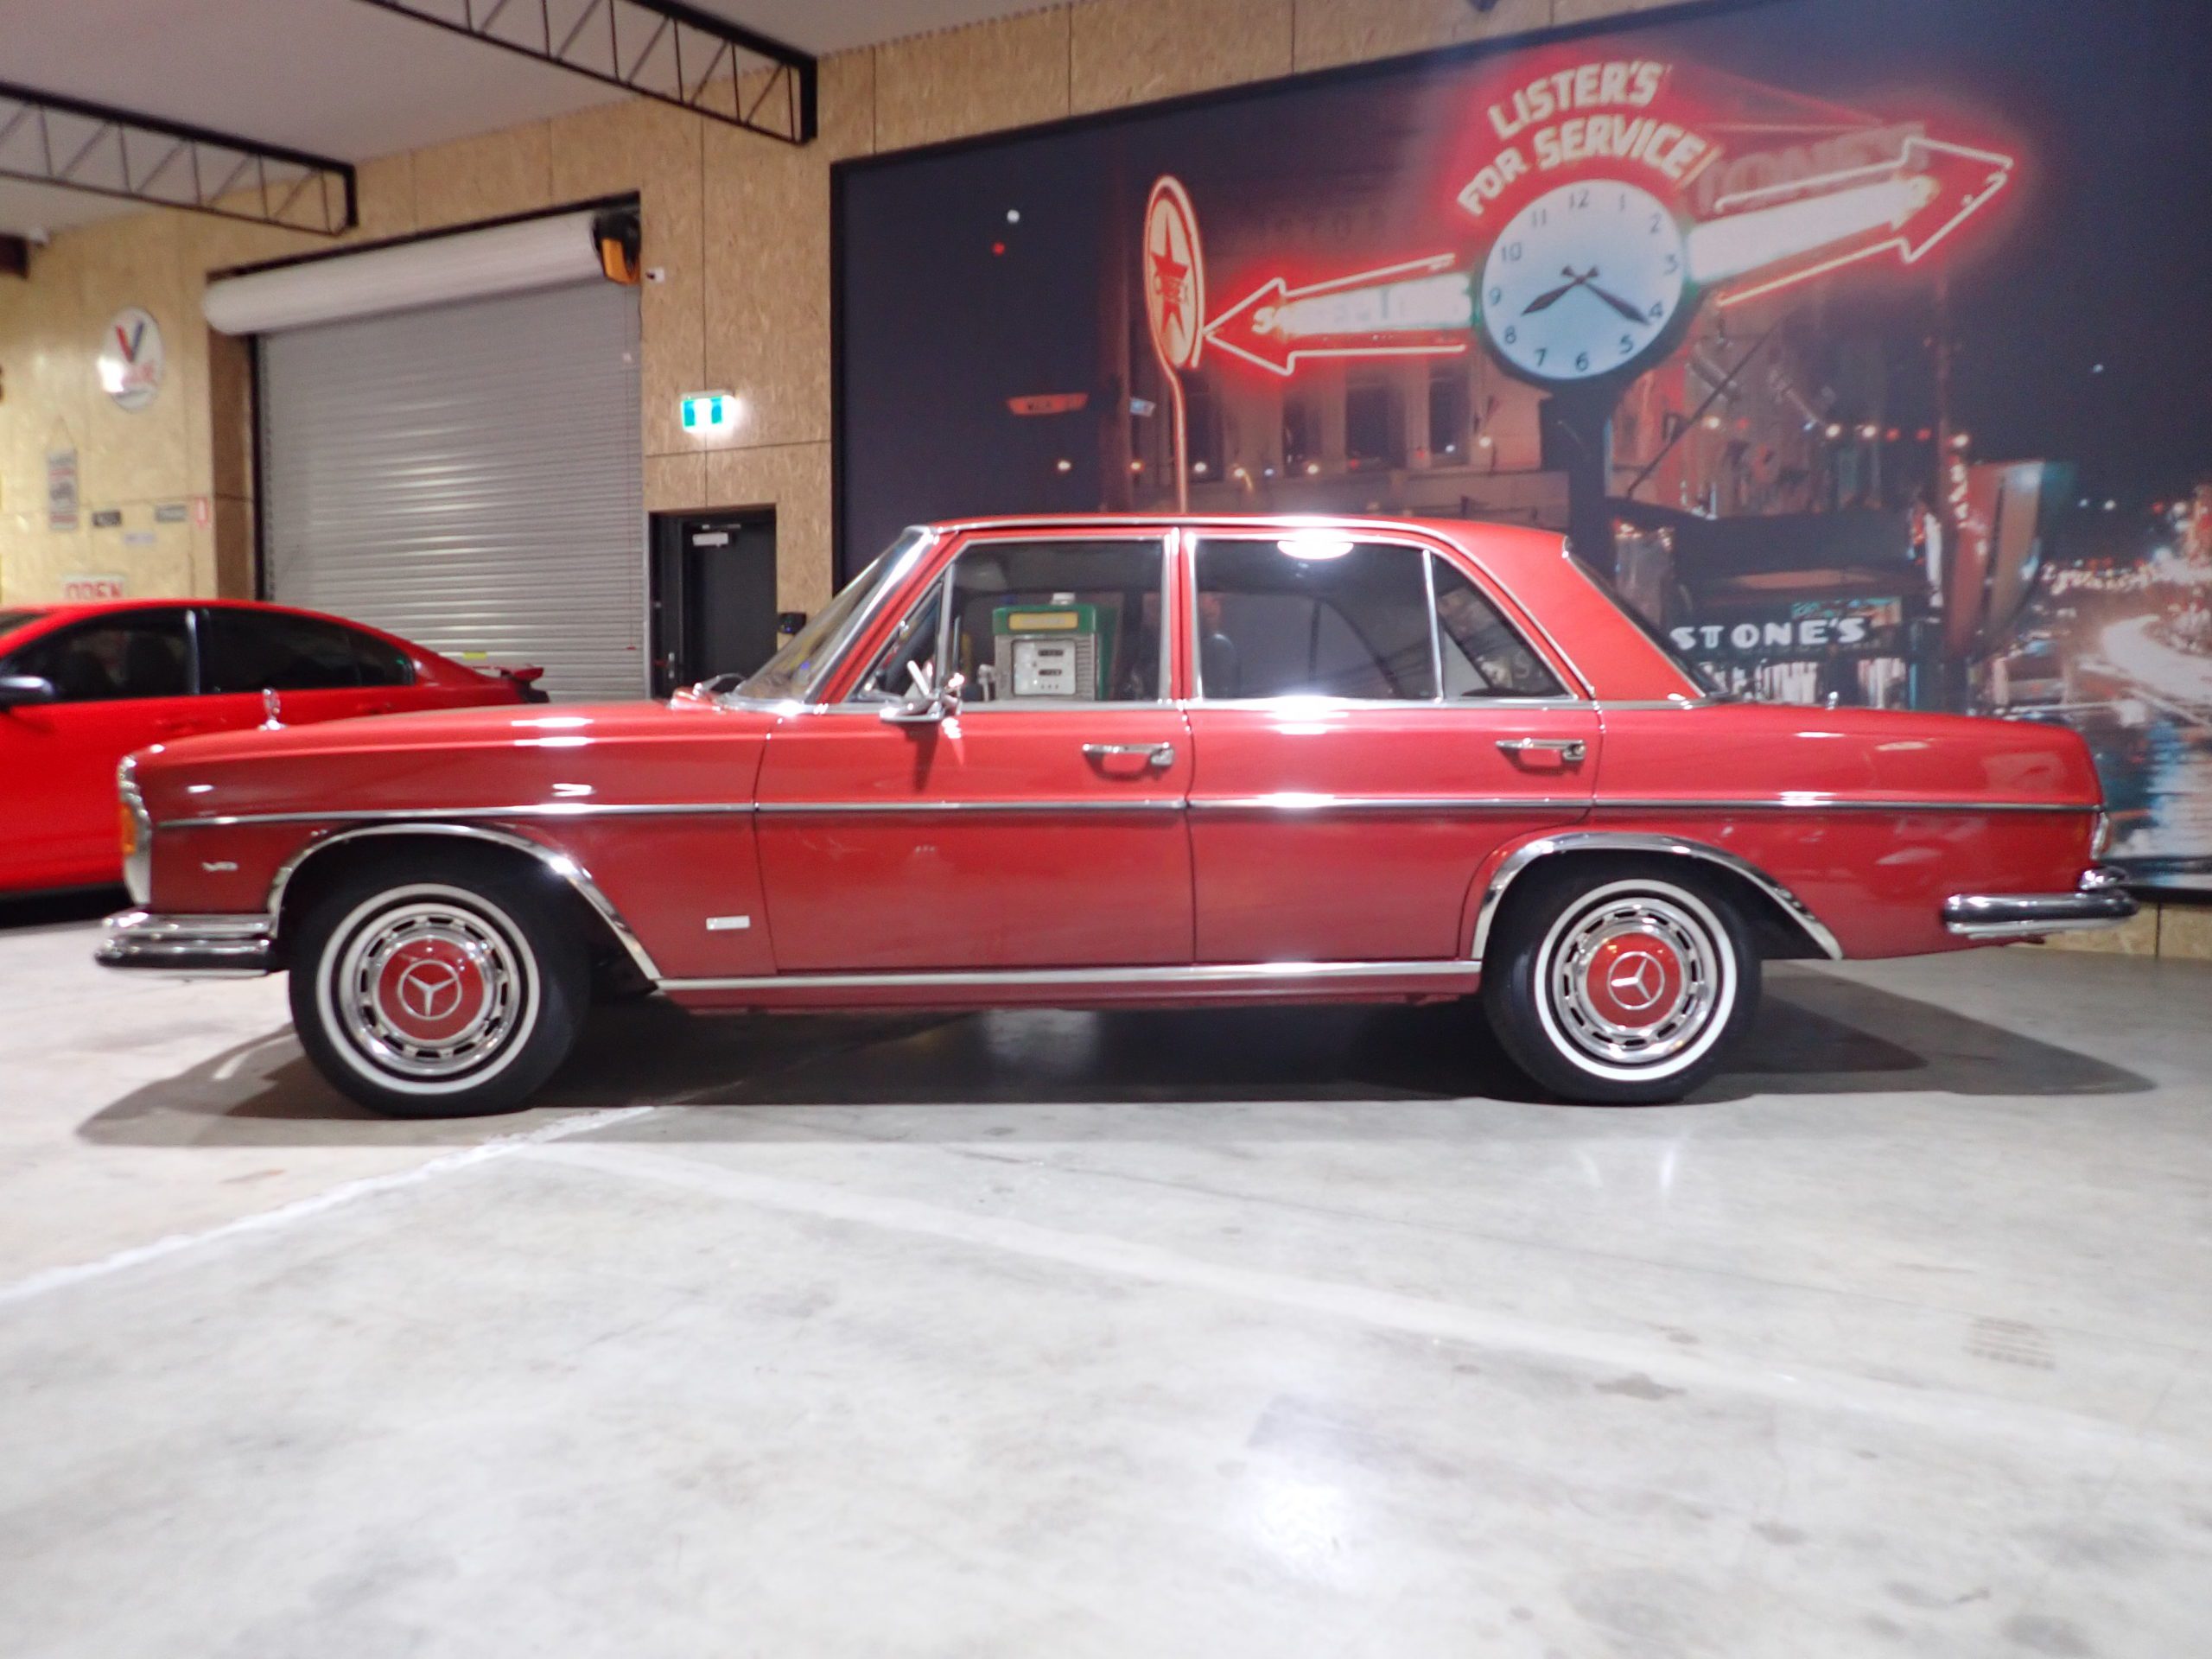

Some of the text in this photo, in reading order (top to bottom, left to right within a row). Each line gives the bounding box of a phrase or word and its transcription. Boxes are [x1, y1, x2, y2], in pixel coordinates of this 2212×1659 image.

[1487, 60, 1664, 141] LISTER'S
[1457, 147, 1529, 216] FOR
[1568, 188, 1590, 210] 12
[1531, 208, 1548, 228] 11
[1649, 213, 1662, 234] 2
[1501, 241, 1522, 262] 10
[1663, 254, 1679, 276] 3
[1490, 286, 1502, 307] 9
[1649, 301, 1664, 319] 4
[1504, 325, 1517, 345] 8
[1618, 334, 1634, 354] 5
[1534, 346, 1548, 367] 7
[1574, 350, 1589, 372] 6
[1669, 617, 1866, 651] STONE'S
